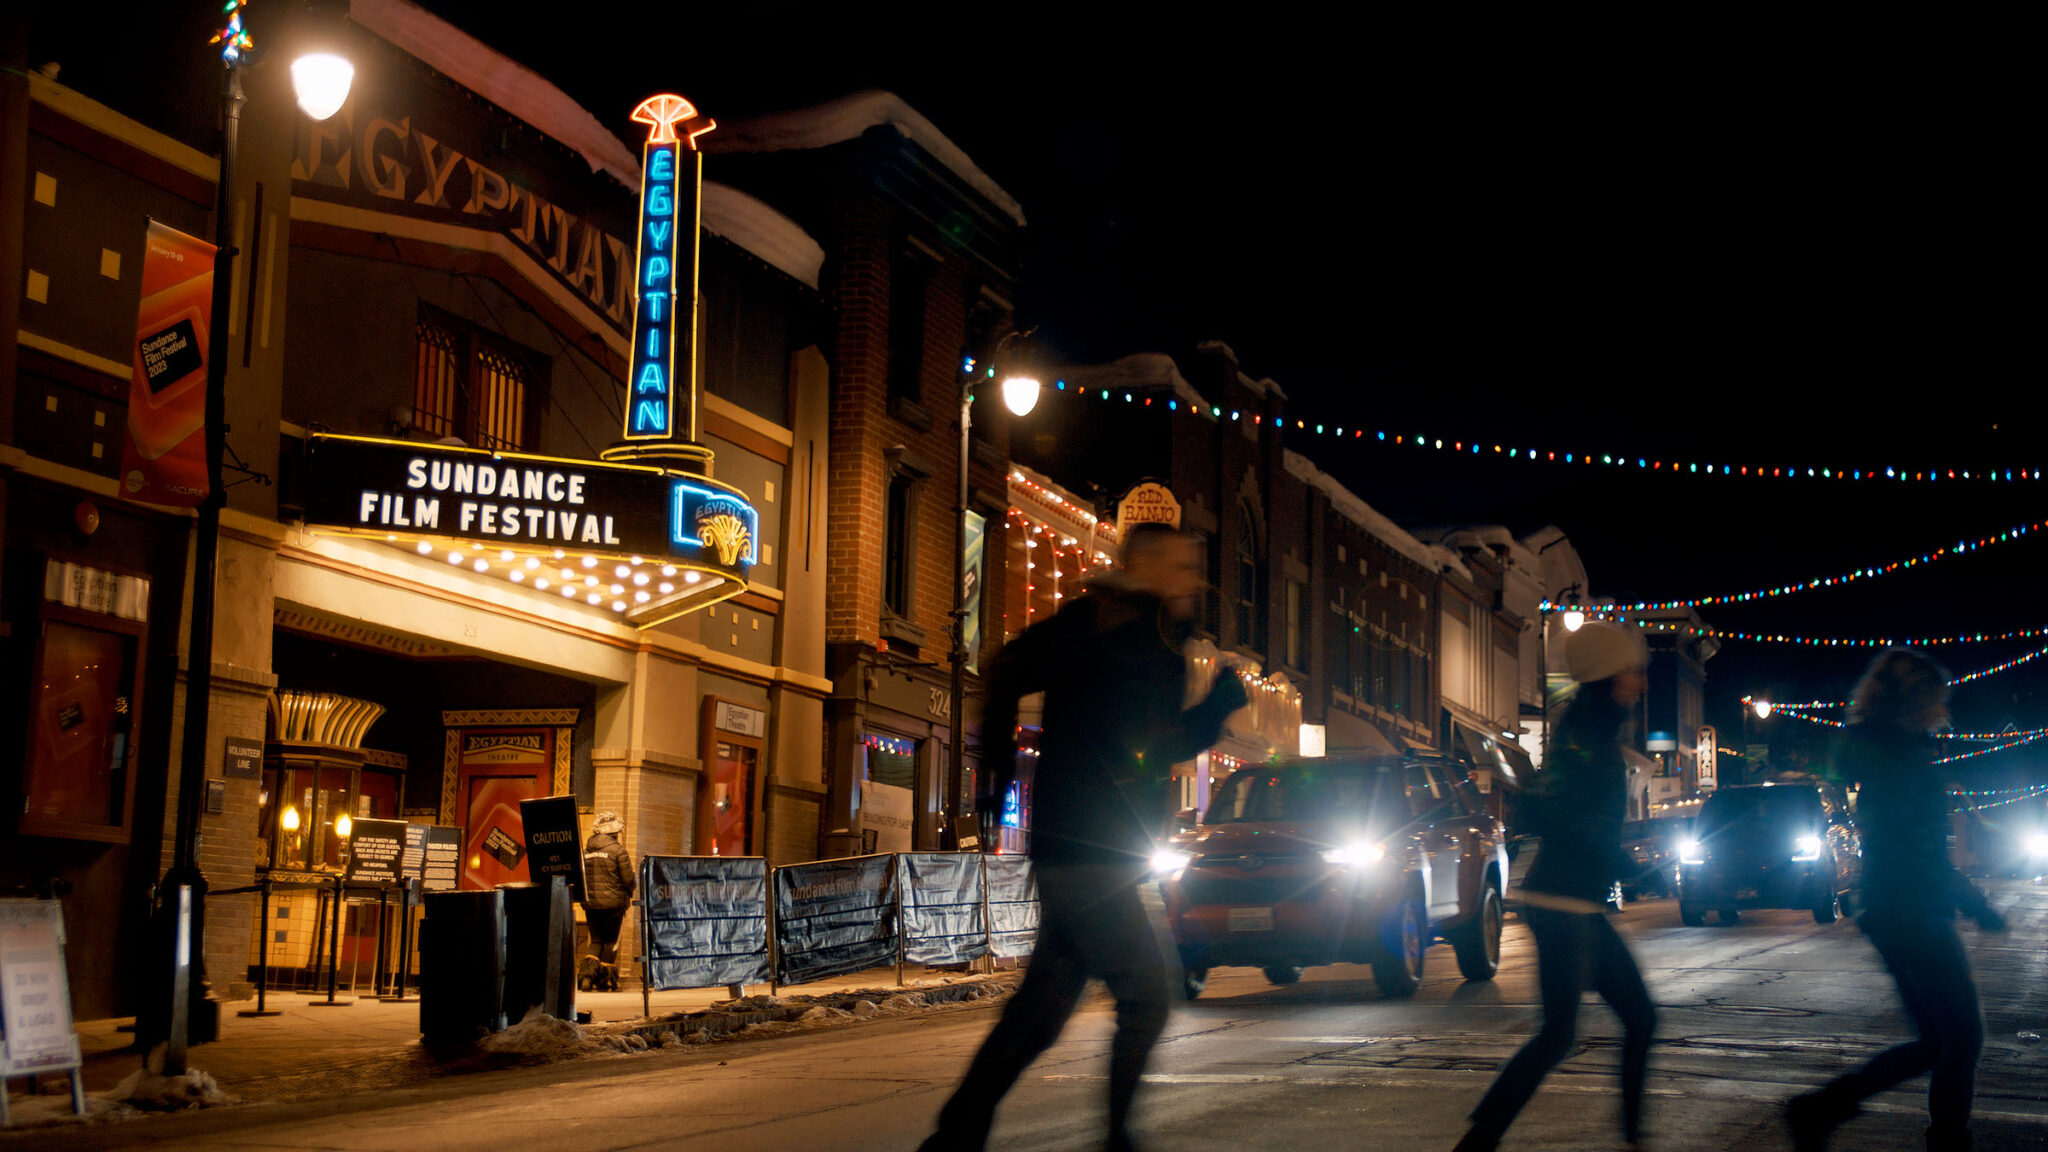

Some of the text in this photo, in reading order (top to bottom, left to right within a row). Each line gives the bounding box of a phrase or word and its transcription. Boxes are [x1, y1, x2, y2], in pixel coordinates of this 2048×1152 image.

[291, 100, 638, 326] EGYPTIAN
[636, 149, 674, 431] EGYPTIAN
[142, 331, 177, 354] Sundance
[145, 336, 187, 367] Film Festival
[148, 360, 168, 378] 2023
[406, 458, 586, 504] SUNDANCE
[1137, 489, 1163, 504] RED
[359, 492, 621, 545] FILM FESTIVAL
[1124, 505, 1175, 521] BANJO
[928, 687, 951, 718] 324
[469, 735, 541, 750] EGYPTIAN
[228, 745, 262, 758] VOLUNTEER
[488, 753, 519, 761] THEATRE
[237, 759, 251, 769] LINE
[532, 830, 573, 845] CAUTION
[549, 863, 573, 872] SURFACE
